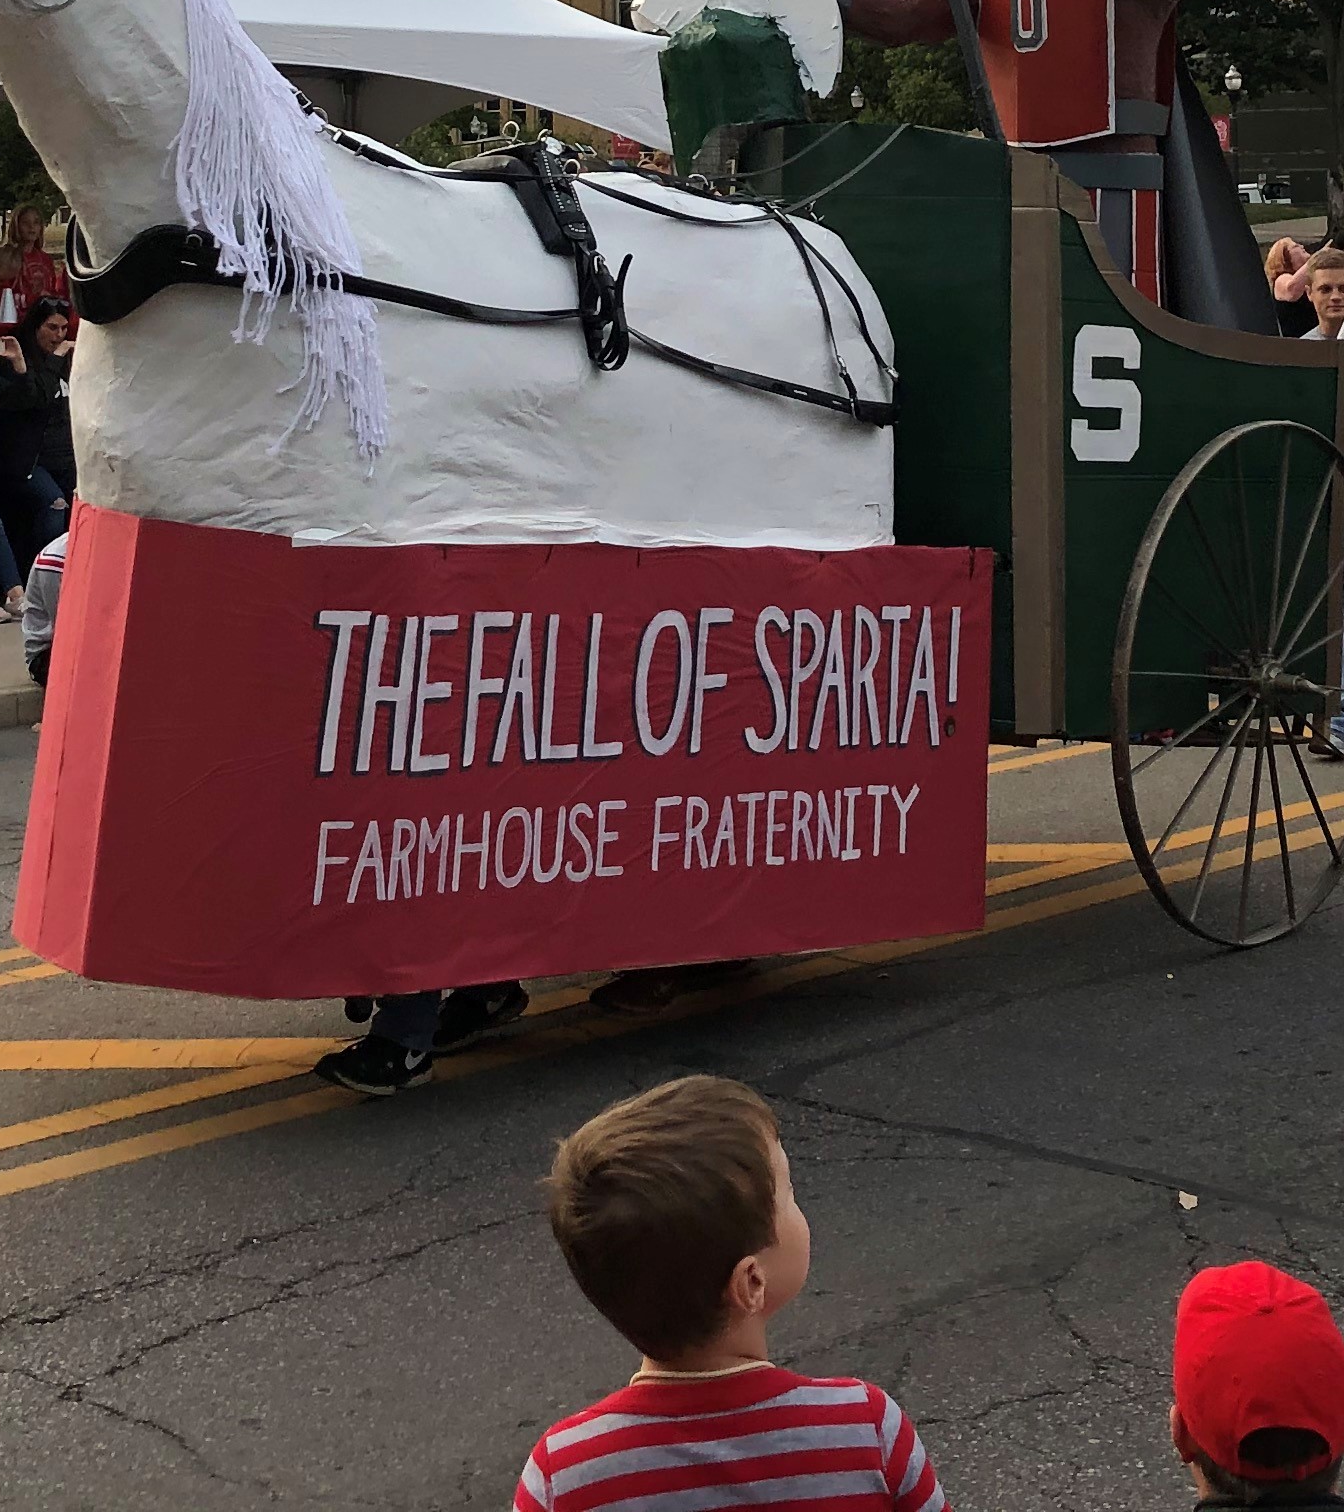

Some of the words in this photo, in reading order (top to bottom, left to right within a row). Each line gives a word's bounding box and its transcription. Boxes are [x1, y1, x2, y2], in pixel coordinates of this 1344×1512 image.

[1070, 324, 1142, 462] S
[316, 610, 460, 774] THE
[462, 610, 624, 768] FALL
[634, 606, 735, 756] OF
[312, 799, 628, 906] FARMHOUSE
[650, 783, 921, 872] FRATERNITY
